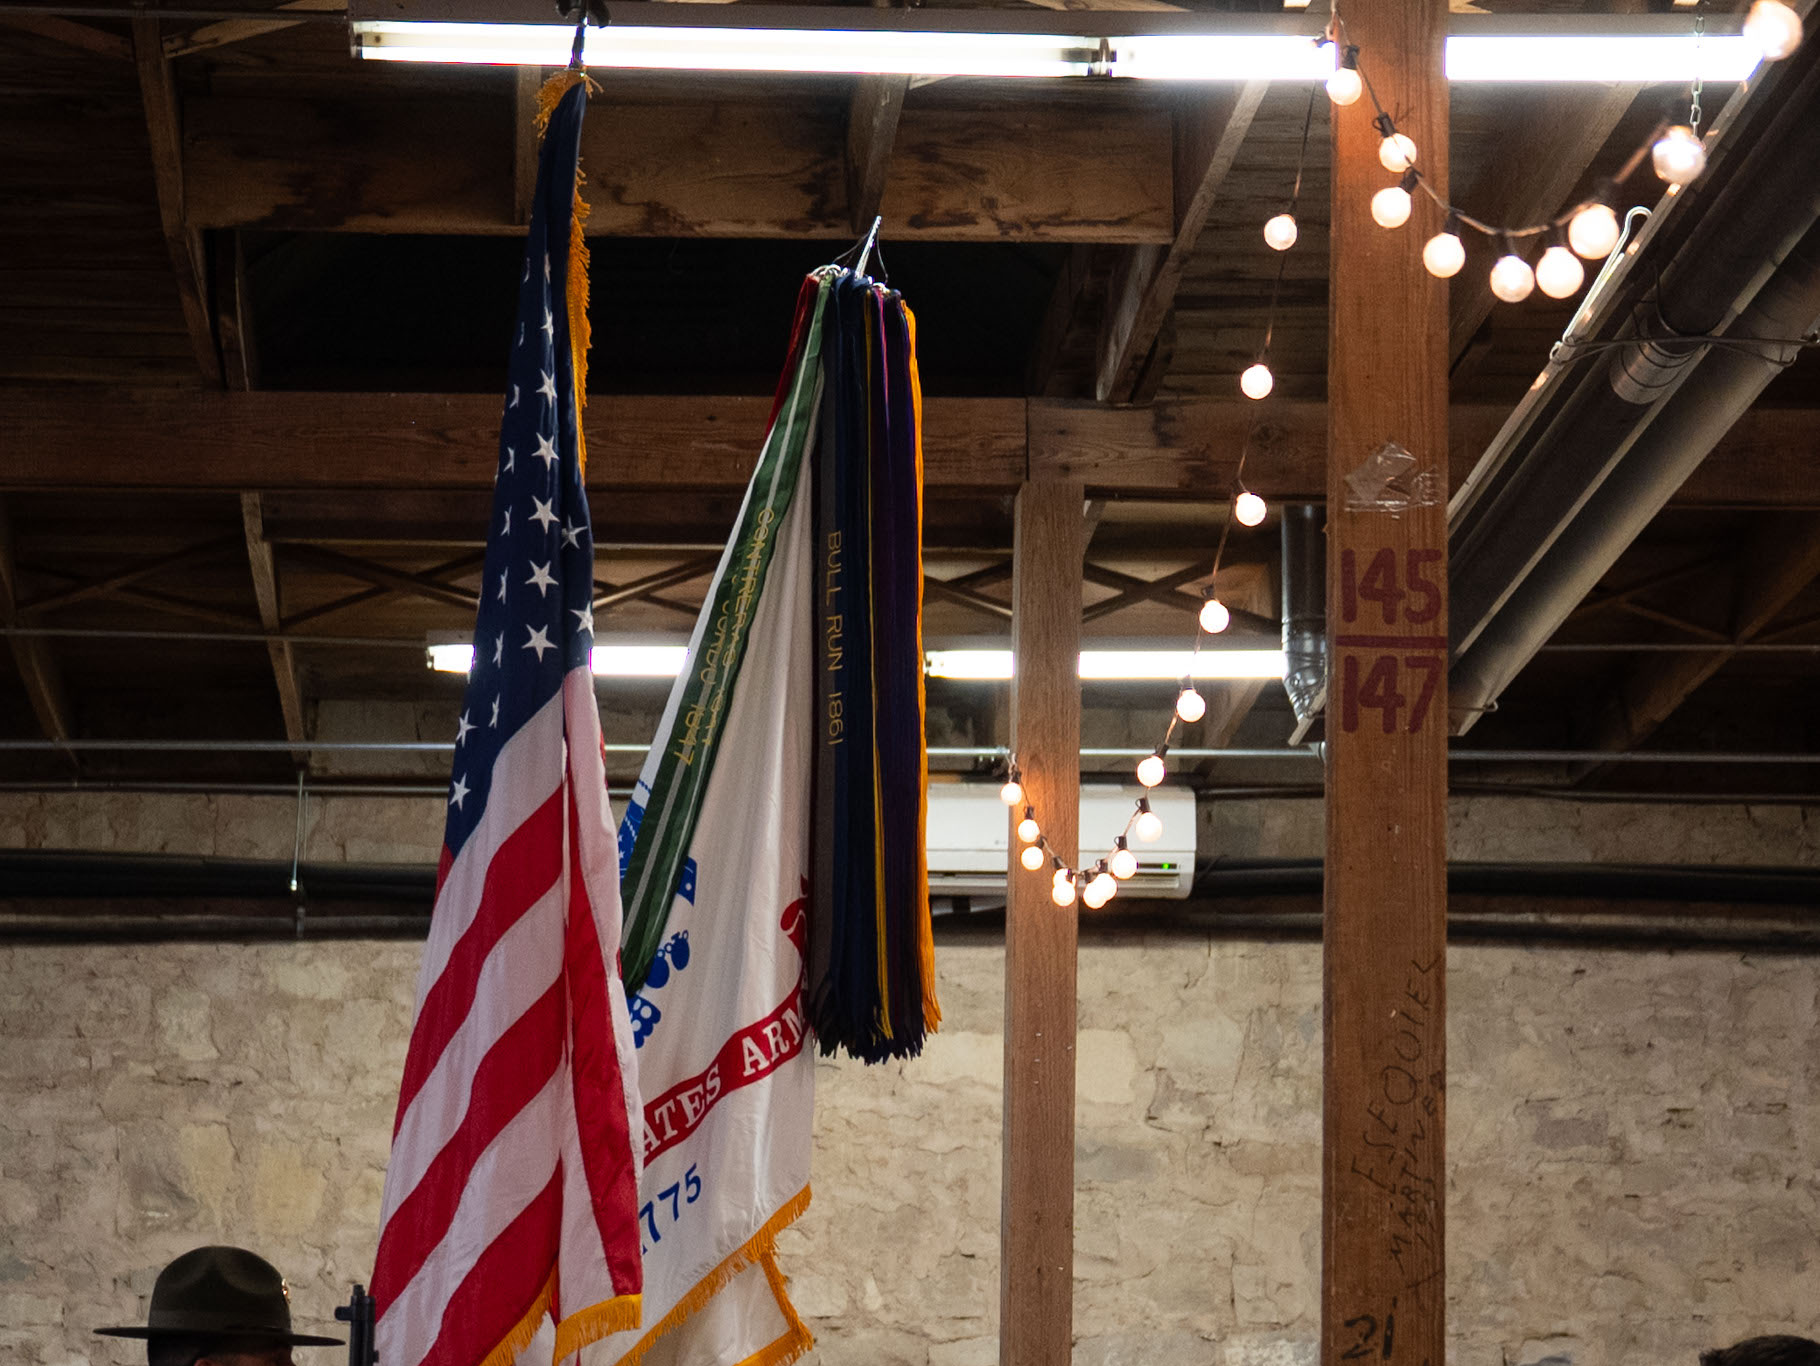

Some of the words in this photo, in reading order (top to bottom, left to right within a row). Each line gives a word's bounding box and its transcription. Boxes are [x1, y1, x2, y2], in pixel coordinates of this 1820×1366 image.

[825, 530, 842, 607] BULL
[1341, 547, 1442, 625] 145
[826, 615, 843, 671] RUN
[827, 691, 844, 745] 1861
[1341, 655, 1442, 734] 147
[639, 1162, 701, 1254] 775
